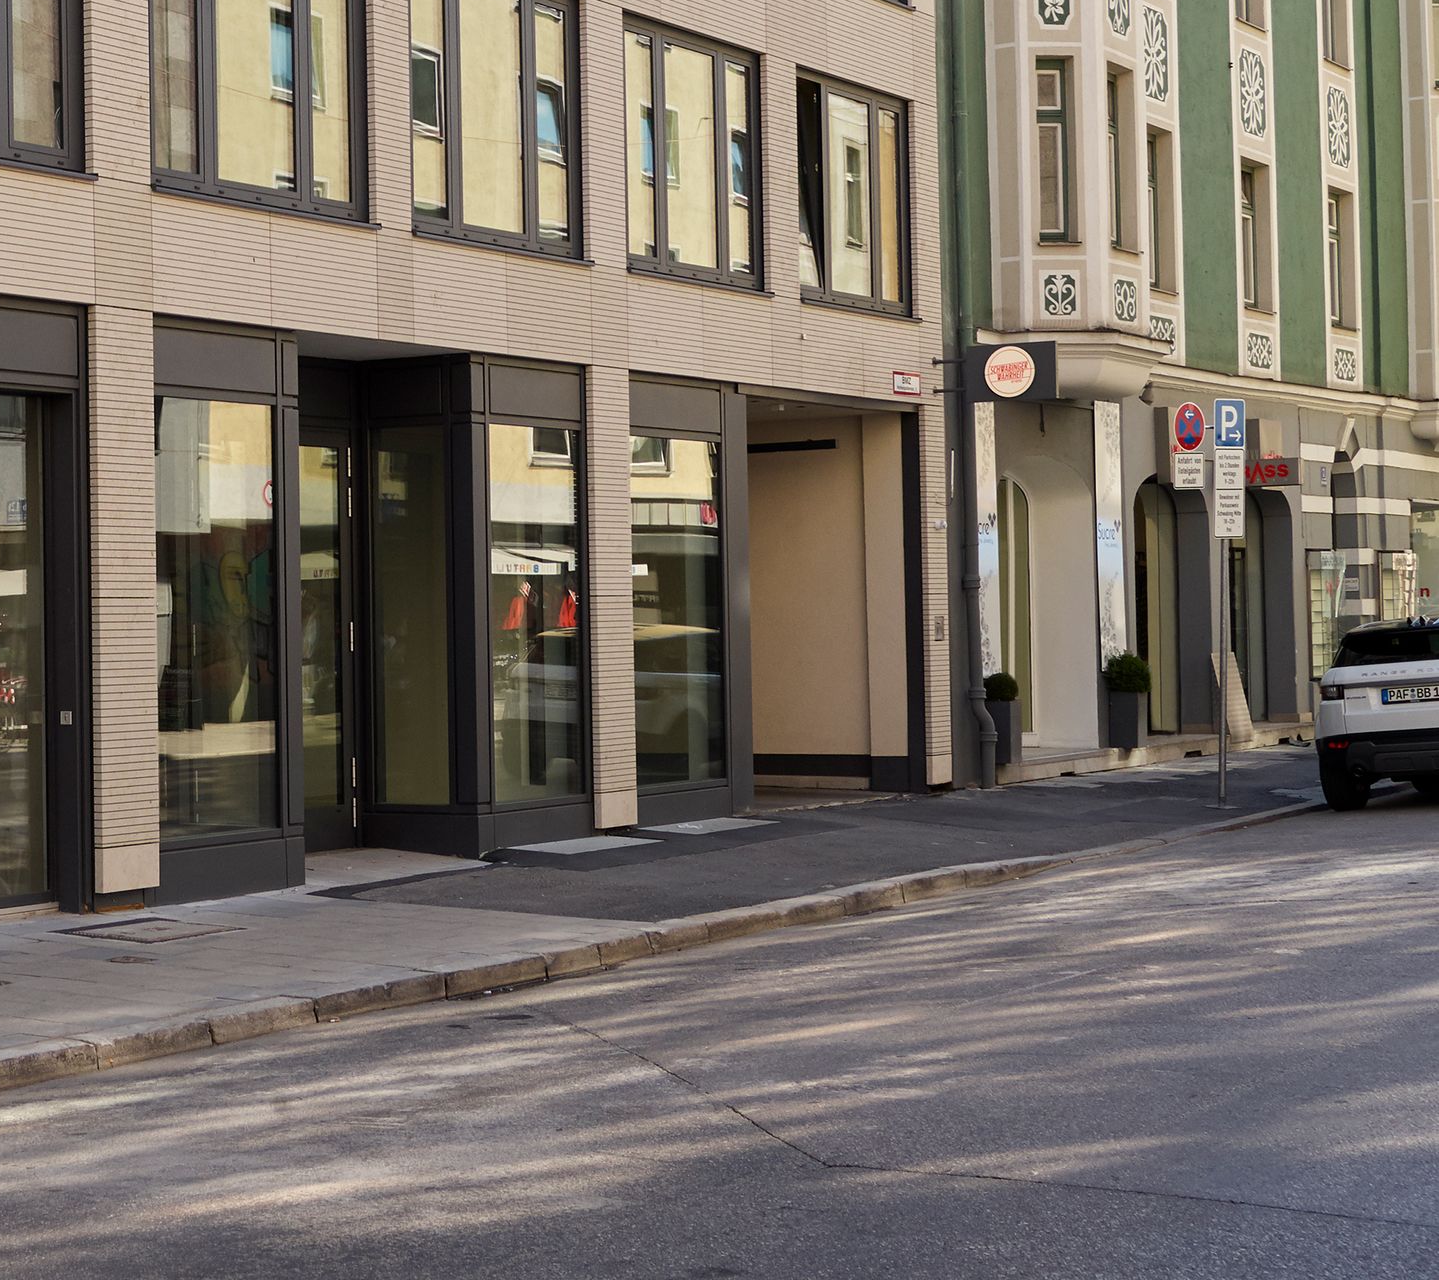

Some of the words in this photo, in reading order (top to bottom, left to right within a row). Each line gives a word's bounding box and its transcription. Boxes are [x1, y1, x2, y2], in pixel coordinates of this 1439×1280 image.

[990, 361, 1028, 375] SCHWABINGER
[1221, 405, 1238, 442] P
[1098, 522, 1116, 540] Sucre
[1361, 669, 1408, 678] RANGE
[1388, 688, 1410, 701] PAF
[1416, 687, 1432, 699] BB
